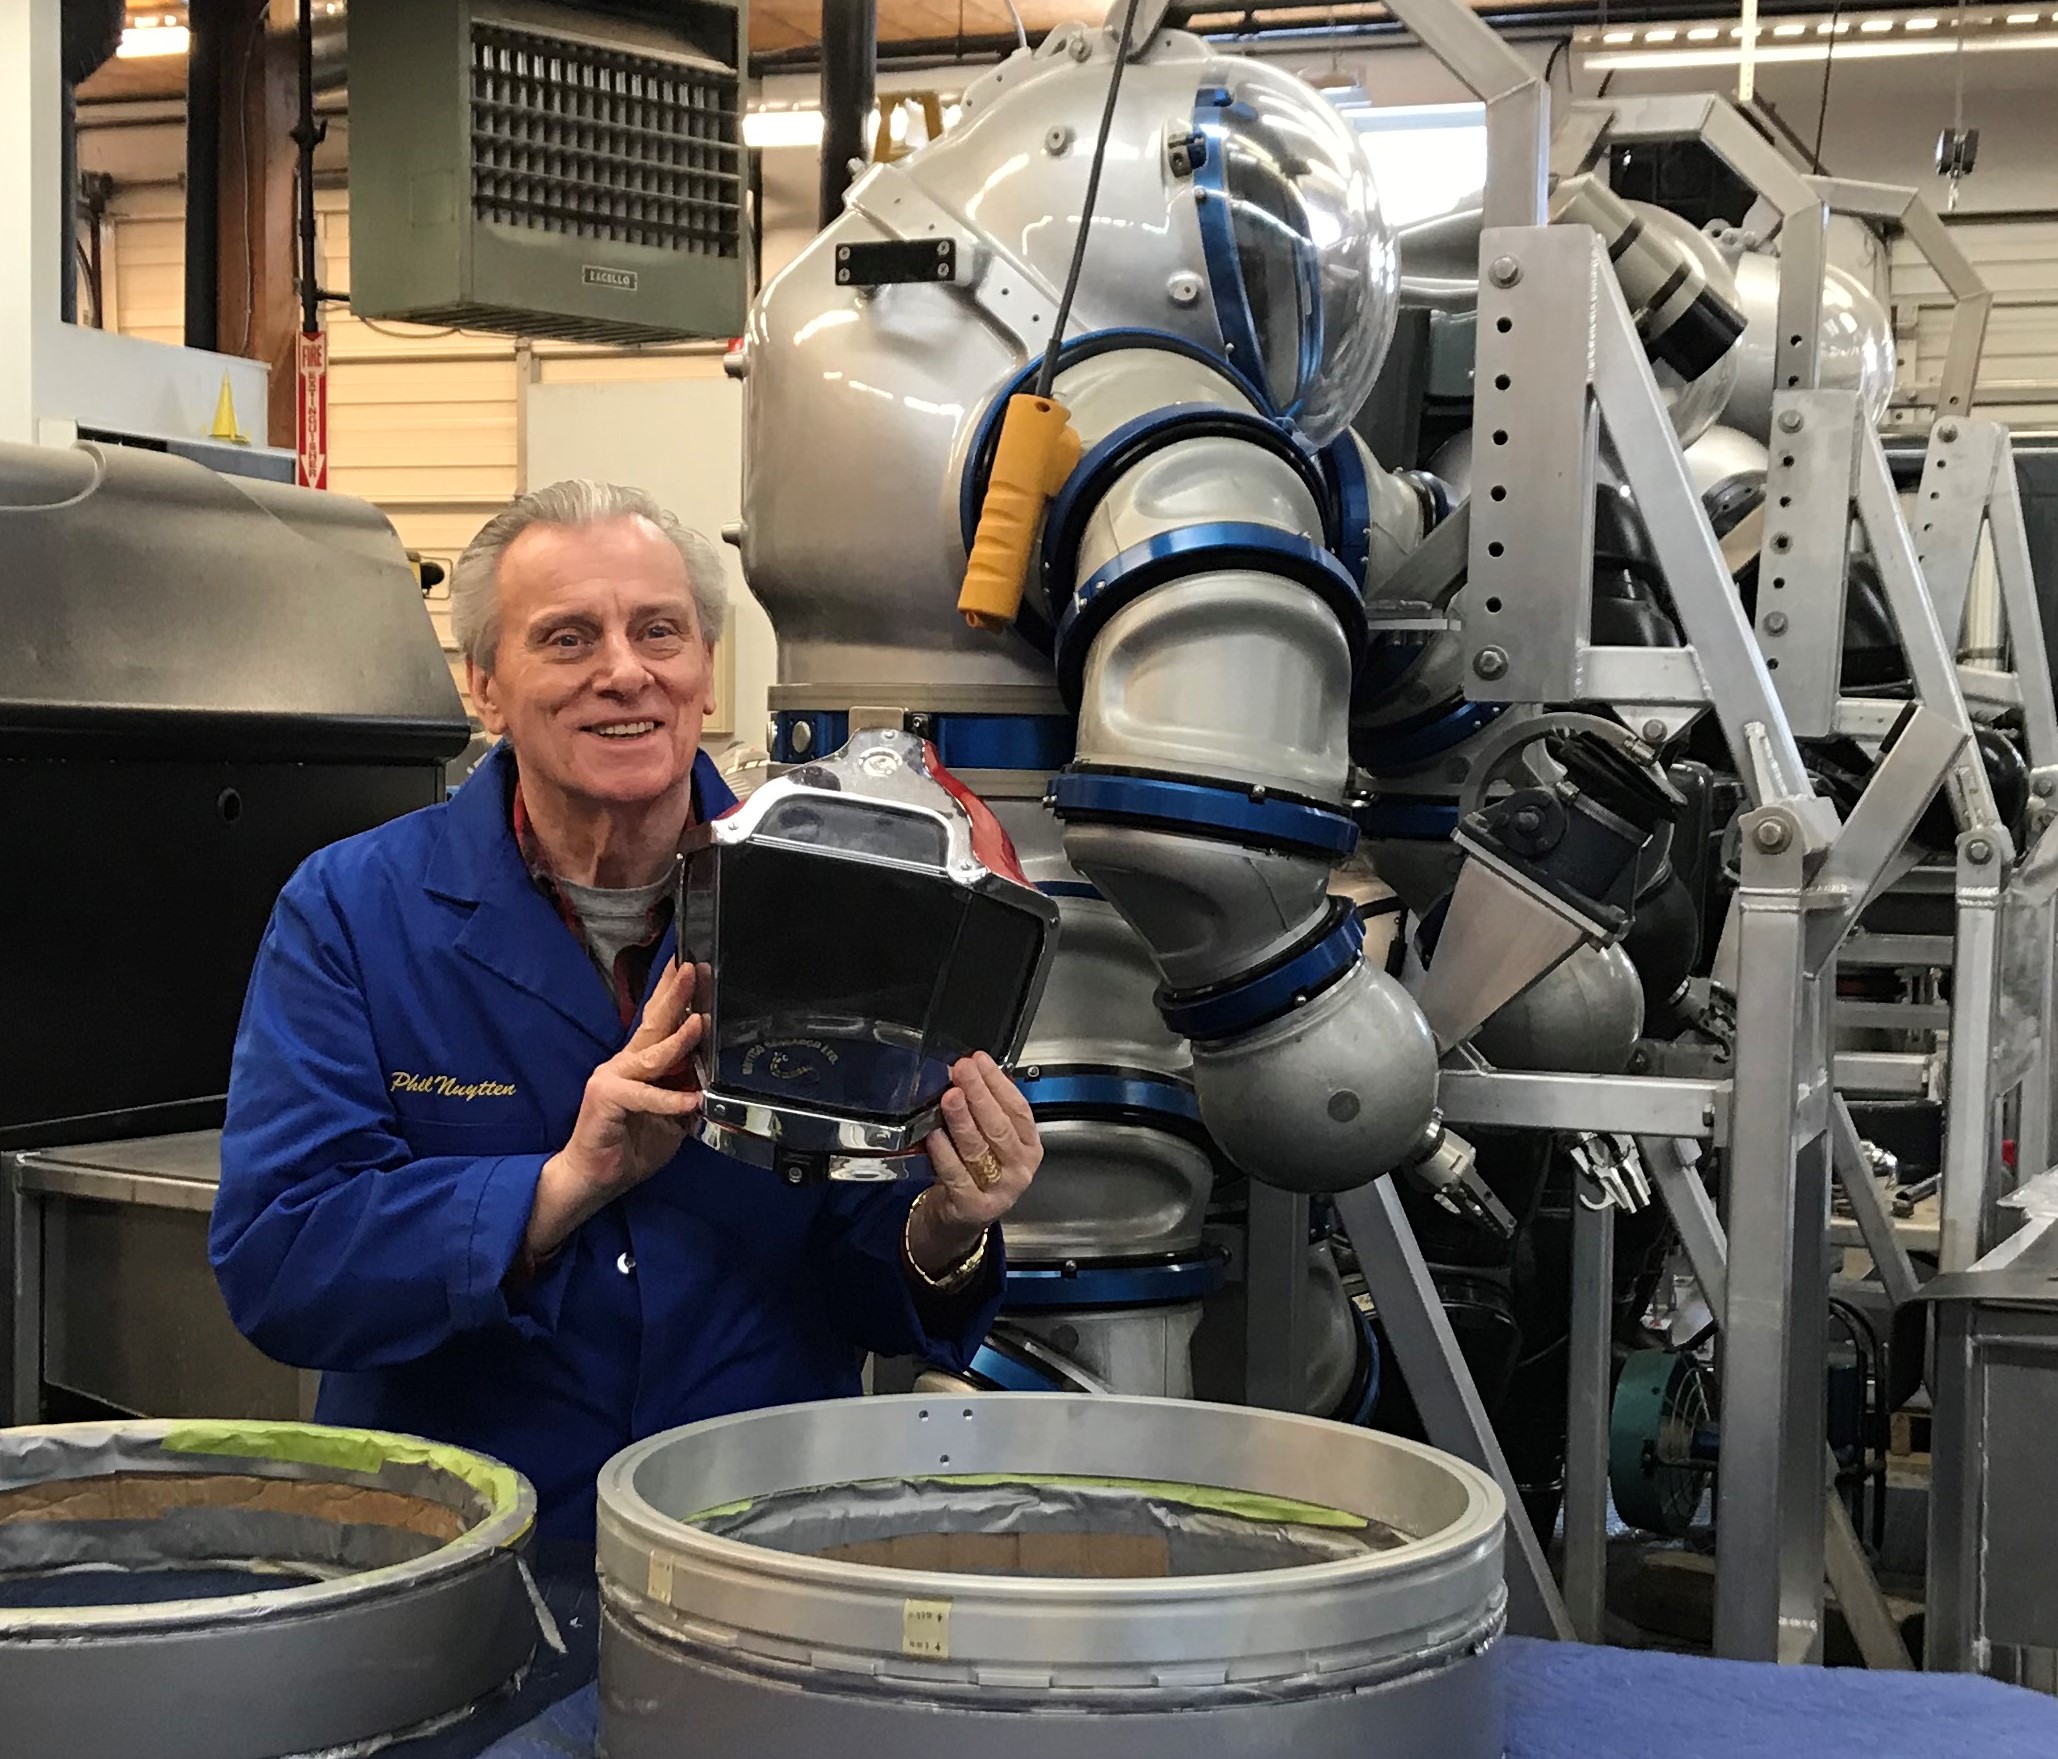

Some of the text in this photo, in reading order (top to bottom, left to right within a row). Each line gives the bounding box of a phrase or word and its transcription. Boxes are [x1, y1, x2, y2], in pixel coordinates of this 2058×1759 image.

[302, 344, 322, 367] FIRE
[308, 371, 317, 477] EXTINGUISHER
[390, 1071, 517, 1101] Phil Nuytten
